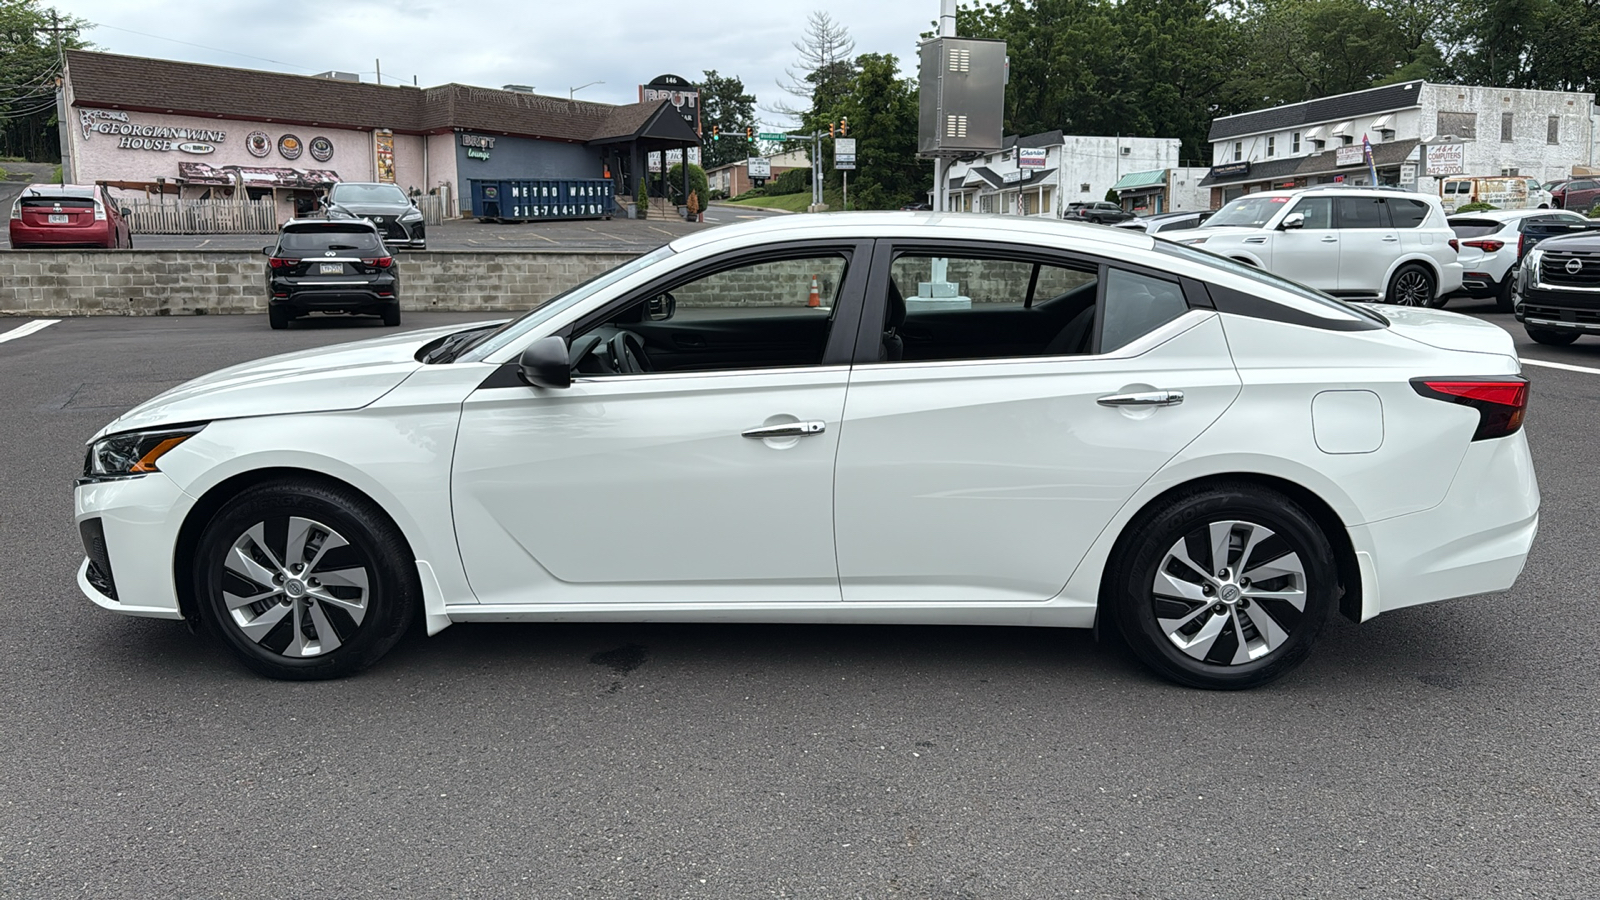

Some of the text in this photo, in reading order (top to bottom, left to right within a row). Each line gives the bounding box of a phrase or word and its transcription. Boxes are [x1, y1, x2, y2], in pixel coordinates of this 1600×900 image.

[99, 123, 226, 143] GEORGIAN WINE
[118, 137, 172, 151] HOUSE
[462, 134, 495, 149] BRUT
[467, 148, 490, 160] Lounge
[1427, 152, 1462, 160] COMPUTERS
[1426, 166, 1463, 174] 942-9700
[512, 186, 609, 197] METRO WASTE
